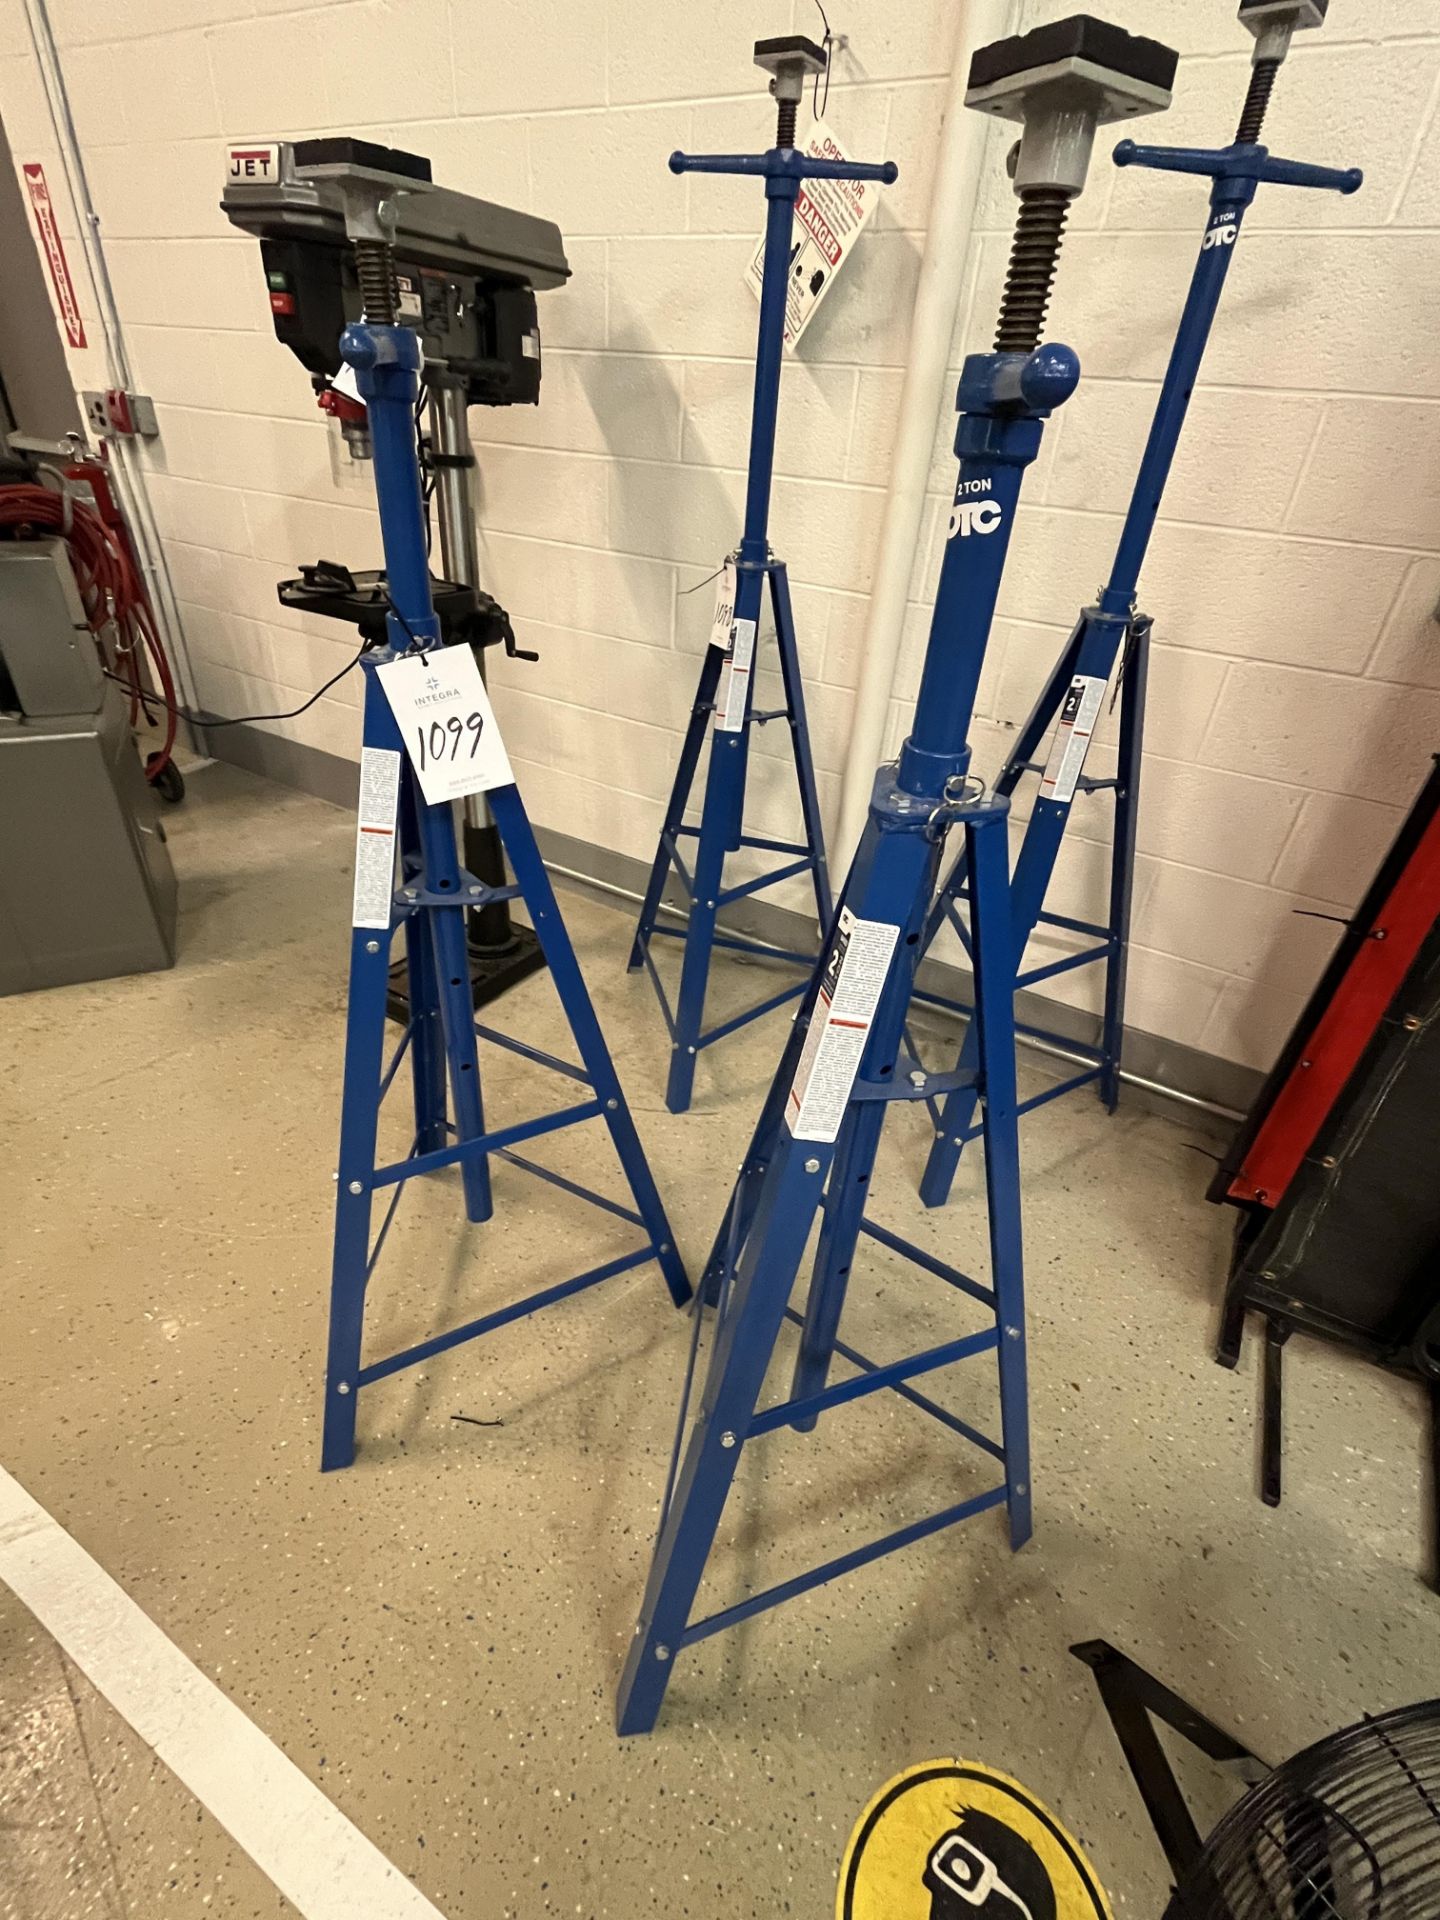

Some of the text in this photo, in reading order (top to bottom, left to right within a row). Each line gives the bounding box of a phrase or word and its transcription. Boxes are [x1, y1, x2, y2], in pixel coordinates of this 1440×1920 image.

[231, 159, 270, 176] JET
[798, 196, 839, 262] DANGER
[1202, 224, 1237, 250] OTC
[963, 477, 992, 494] TON
[414, 688, 462, 706] INTEGRA
[1066, 697, 1076, 712] 2
[418, 711, 484, 772] 1099
[828, 948, 840, 977] 2
